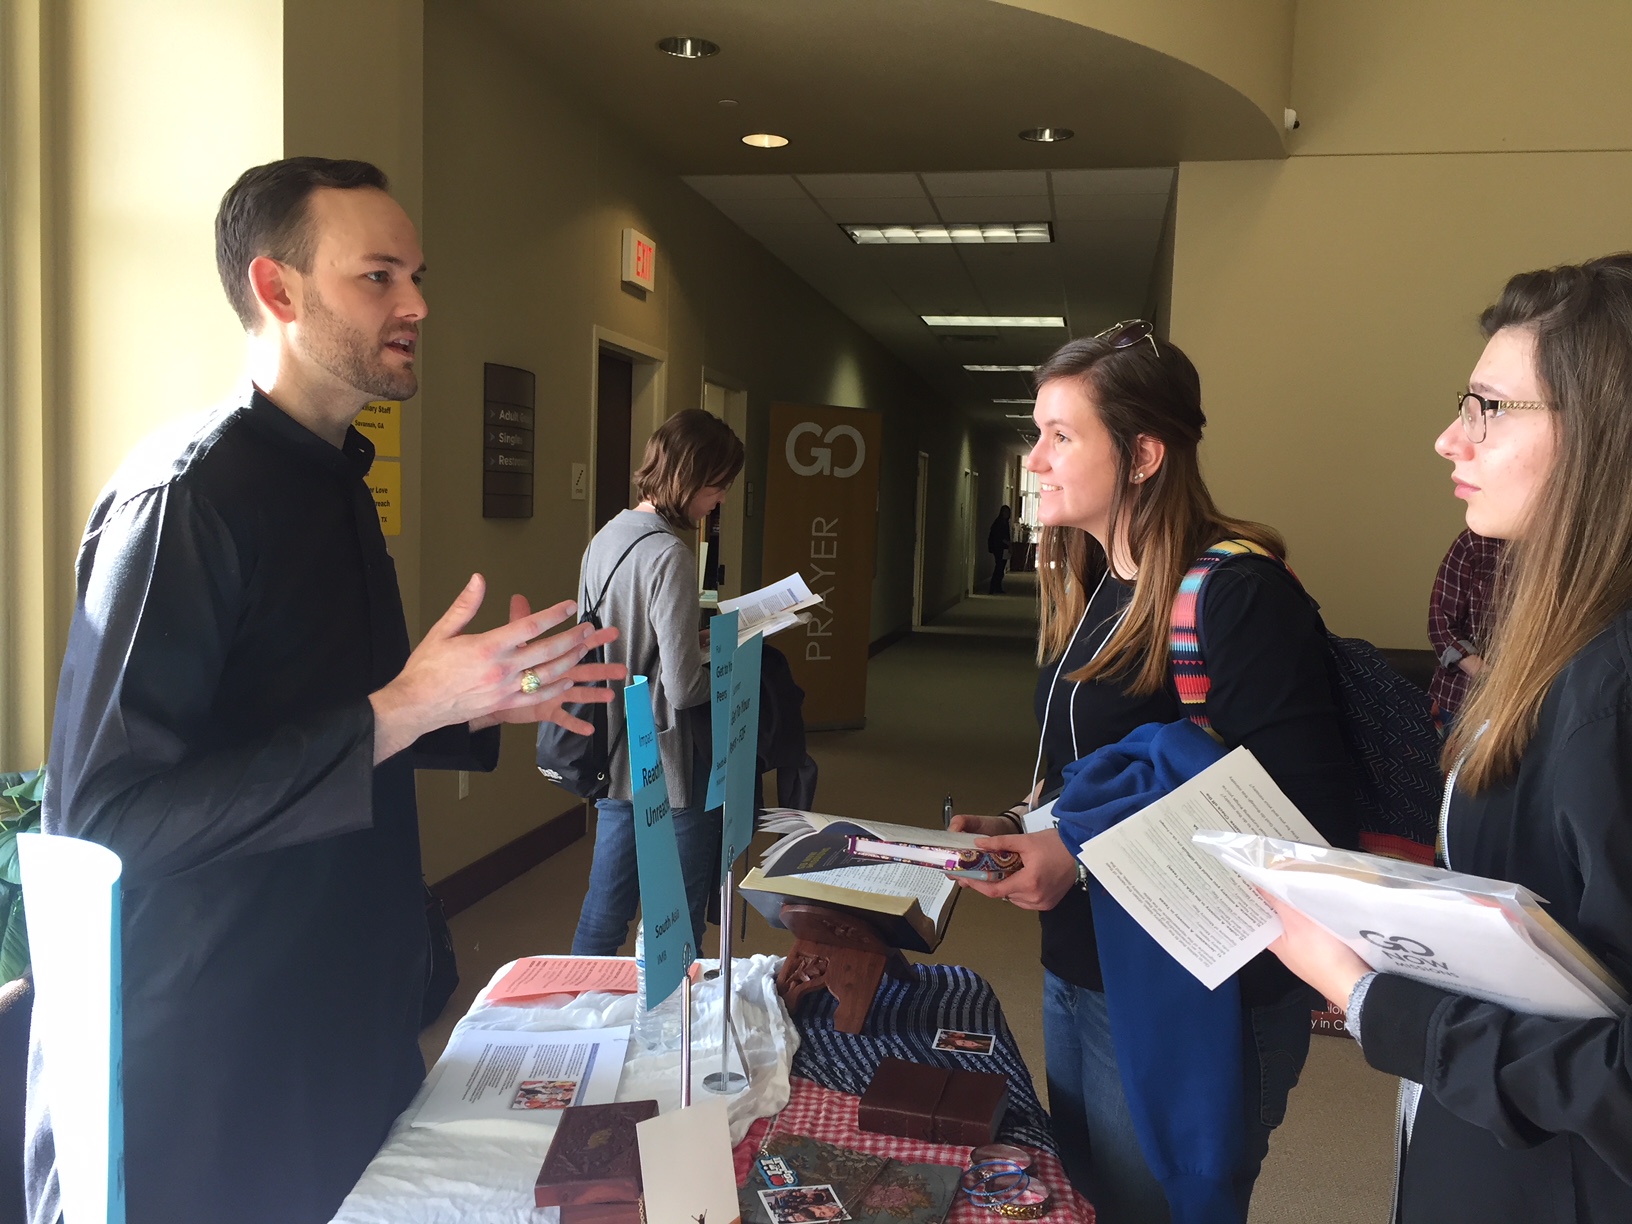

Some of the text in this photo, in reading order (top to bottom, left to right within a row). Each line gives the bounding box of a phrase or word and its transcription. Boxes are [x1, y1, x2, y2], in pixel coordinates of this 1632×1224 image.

[637, 240, 653, 281] EXIT
[378, 405, 391, 414] Staff
[376, 486, 388, 494] Love
[806, 516, 838, 661] PRAYER
[1157, 896, 1171, 910] Texas
[655, 915, 672, 938] South
[1381, 950, 1449, 970] NOW
[1395, 961, 1460, 979] MISSIONS
[1320, 1017, 1330, 1028] in
